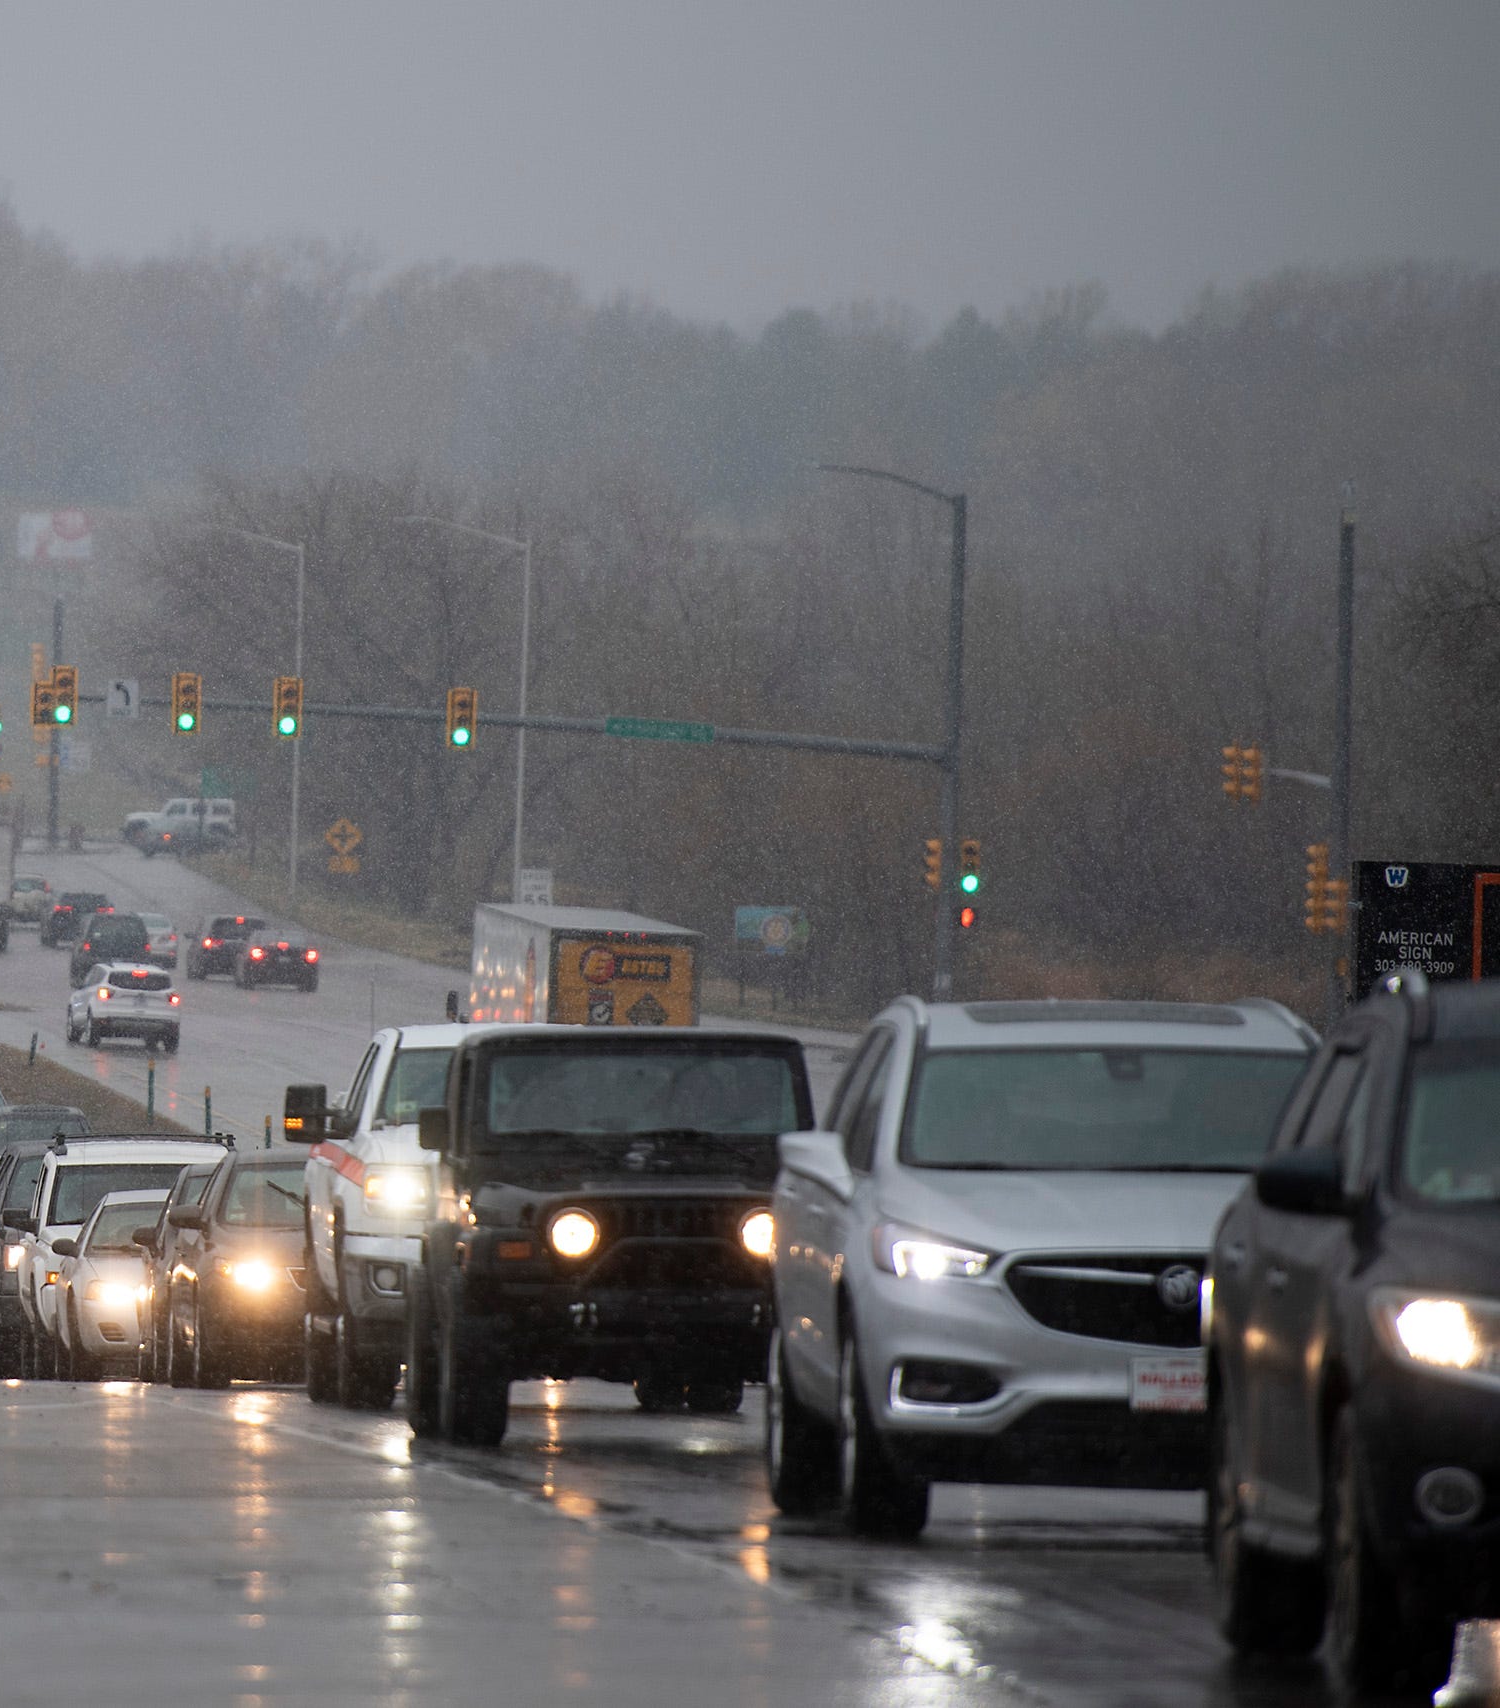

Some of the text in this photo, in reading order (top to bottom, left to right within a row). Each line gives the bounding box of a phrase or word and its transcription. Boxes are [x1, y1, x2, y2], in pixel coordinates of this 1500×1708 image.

[1377, 931, 1453, 946] AMERICAN
[1398, 946, 1432, 960] SIGN
[1374, 959, 1454, 974] 303-680-3909
